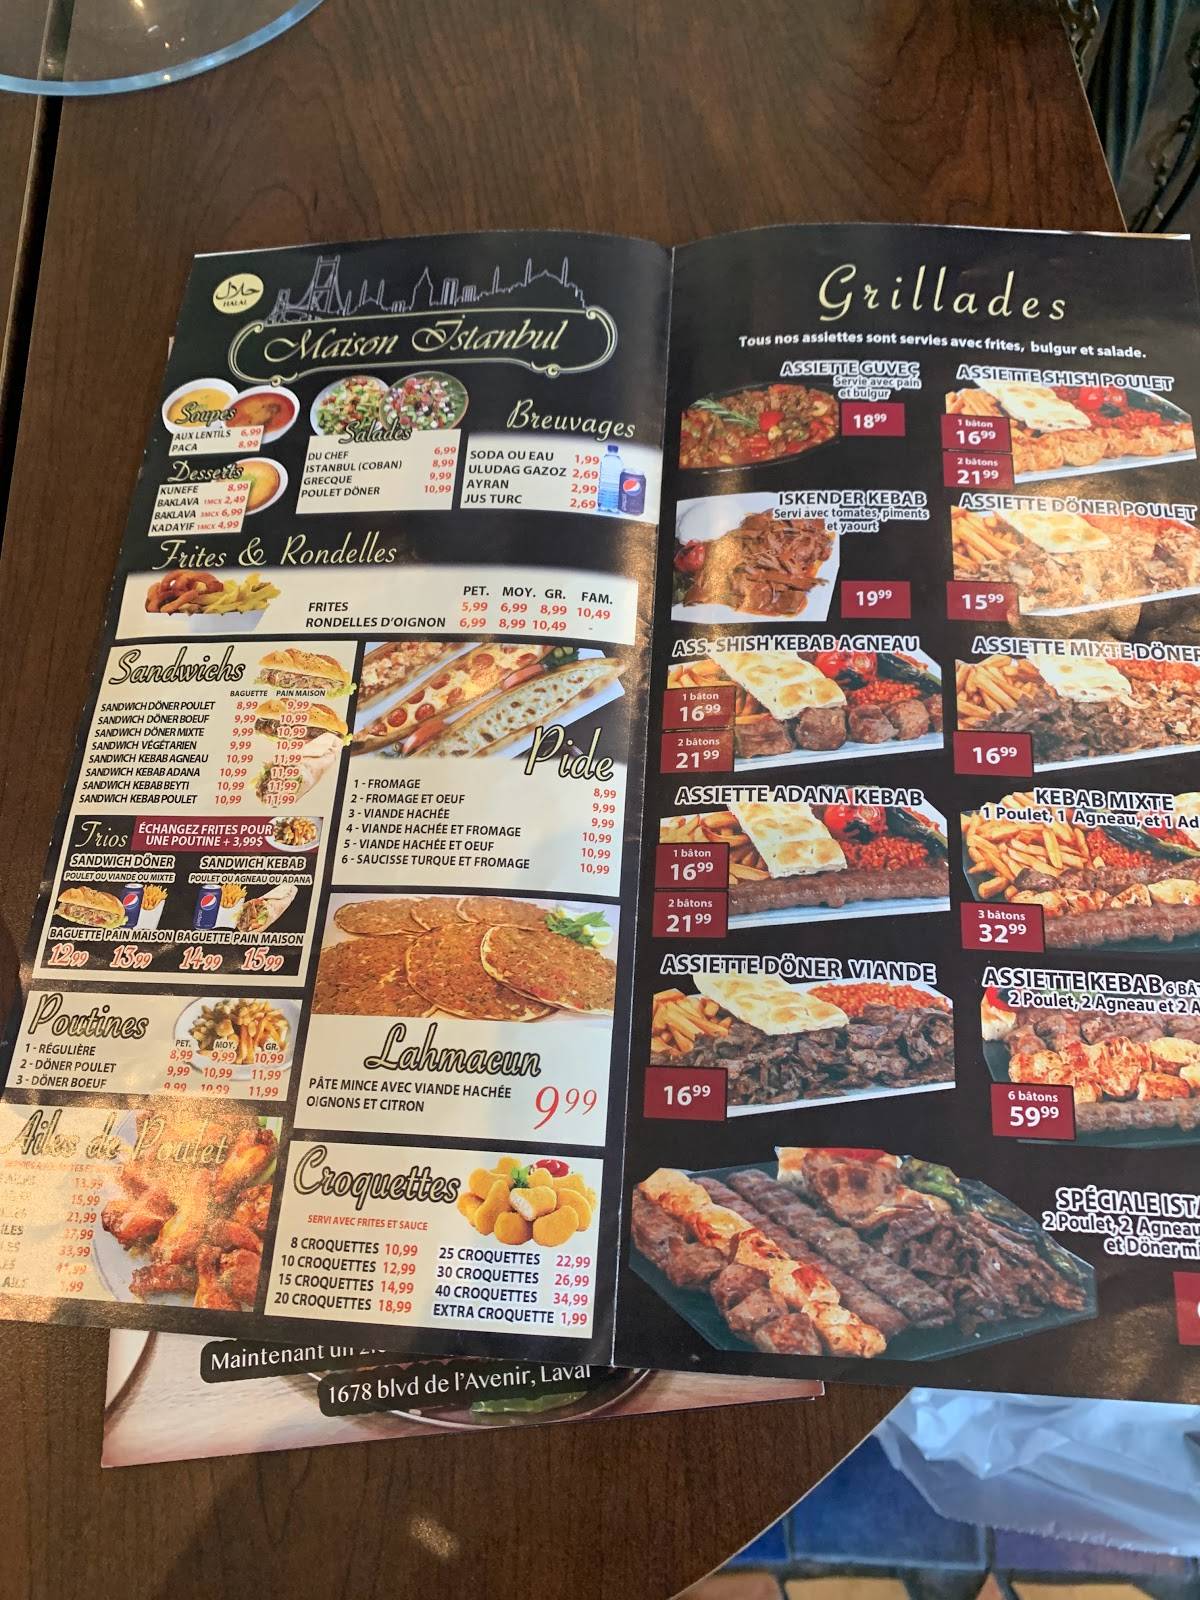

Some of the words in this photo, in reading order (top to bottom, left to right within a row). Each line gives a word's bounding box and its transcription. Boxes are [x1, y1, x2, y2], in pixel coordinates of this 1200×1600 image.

[818, 263, 1066, 322] Grillades
[264, 327, 399, 363] Maison
[738, 334, 772, 348] Tous
[774, 333, 799, 345] nos
[802, 330, 863, 343] assiettes
[866, 333, 897, 344] sont
[900, 334, 948, 346] servies
[950, 338, 982, 349] avec
[985, 338, 1024, 353] frites,
[1030, 341, 1076, 357] bulgur
[1080, 344, 1094, 356] et
[1097, 345, 1146, 358] salade.
[780, 360, 858, 376] ASSIETTE
[956, 364, 1043, 380] ASSIETTE
[1043, 371, 1099, 386] SHISH
[1100, 374, 1175, 391] POULET
[833, 375, 869, 388] Servie
[870, 378, 895, 387] avec
[895, 376, 921, 389] pain
[838, 389, 853, 398] et
[852, 388, 890, 401] bulgur
[174, 401, 237, 427] Soupes
[506, 399, 635, 441] Breuvages
[338, 418, 412, 444] Salades
[965, 420, 993, 428] bâton
[174, 431, 193, 440] AUX
[195, 429, 231, 439] LENTILS
[171, 444, 197, 452] PACA
[308, 452, 322, 461] DU
[324, 451, 349, 460] CHEF
[434, 446, 456, 455] 6,99
[470, 450, 504, 460] SODA
[507, 451, 526, 460] OU
[529, 452, 554, 461] EAU
[575, 454, 600, 465] 1,99
[167, 460, 244, 482] Desserts
[305, 464, 356, 473] ISTANBUL
[358, 460, 402, 471] (COBAN)
[468, 465, 520, 474] ULUDAG
[523, 466, 567, 477] GAZOZ
[965, 458, 998, 467] bâtons
[303, 475, 352, 485] GRECQUE
[466, 479, 509, 489] AYRAN
[160, 485, 199, 495] KUNEFE
[301, 488, 341, 497] POULET
[344, 485, 380, 496] DÖNER
[424, 485, 451, 494] 10,99
[464, 494, 486, 504] JUS
[489, 495, 522, 504] TURC
[777, 491, 865, 507] ISKENDER
[866, 490, 927, 507] KEBAB
[157, 497, 199, 507] BAKLAVA
[773, 508, 801, 520] Servi
[803, 508, 830, 519] avec
[831, 508, 880, 520] tomates,
[881, 508, 930, 521] piments
[151, 522, 195, 532] KADAYIF
[825, 522, 839, 532] et
[840, 521, 879, 534] yaourt
[152, 539, 227, 570] Frites
[238, 537, 266, 567] &
[280, 531, 397, 565] Rondelles
[463, 585, 489, 597] PET.
[502, 586, 536, 598] MOY.
[545, 588, 566, 600] GR.
[581, 591, 613, 605] FAM.
[308, 601, 348, 612] FRITES
[461, 601, 488, 613] 5,99
[306, 617, 378, 628] RONDELLES
[672, 639, 714, 657] ASS.
[715, 635, 770, 653] SHISH
[774, 635, 835, 652] KEBAB
[837, 635, 920, 653] AGNEAU
[971, 636, 1066, 656] ASSIETTE
[1069, 641, 1132, 660] MIXTE
[108, 645, 246, 685] Sandwichs
[100, 701, 147, 712] SANDWICH
[148, 700, 179, 711] DÖNER
[180, 701, 215, 710] POULET
[92, 741, 139, 750] SANDWICH
[141, 739, 197, 750] VÉGÉTARIEN
[524, 724, 614, 782] Pide
[367, 779, 421, 789] FROMAGE
[593, 788, 617, 799] 8,99
[674, 785, 770, 806] ASSIETTE
[771, 785, 847, 805] ADANA
[853, 788, 925, 807] KEBAB
[1033, 788, 1109, 809] KEBAB
[1109, 791, 1175, 812] MIXTE
[995, 806, 1053, 822] Poulet,
[1073, 809, 1141, 828] Agneau,
[74, 820, 128, 848] Trios
[138, 823, 200, 835] ÉCHANGEZ
[201, 824, 237, 835] FRITES
[239, 824, 273, 835] POUR
[146, 836, 169, 846] UNE
[171, 836, 221, 846] POUTINE
[233, 835, 263, 848] 3,99$
[356, 854, 409, 865] SAUCISSE
[411, 855, 456, 867] TURQUE
[458, 856, 472, 867] ET
[474, 857, 530, 869] FROMAGE
[580, 863, 609, 875] 10,99
[660, 953, 762, 975] ASSIETTE
[764, 952, 842, 980] DÖNER
[849, 960, 938, 984] VIANDE
[982, 966, 1085, 989] ASSIETTE
[1088, 973, 1165, 995] KEBAB
[27, 992, 149, 1040] Poutines
[38, 1042, 96, 1056] RÉGULIÈRE
[363, 1022, 542, 1078] Lahmacun
[35, 1058, 72, 1071] DÖNER
[74, 1061, 116, 1073] POULET
[309, 1076, 338, 1090] PÂTE
[340, 1079, 378, 1092] MINCE
[380, 1081, 412, 1094] AVEC
[415, 1082, 459, 1096] VIANDE
[462, 1084, 512, 1099] HACHÉE
[306, 1096, 361, 1110] OIGNONS
[363, 1099, 377, 1110] ET
[380, 1099, 425, 1112] CITRON
[293, 1145, 461, 1211] Croquettes
[1055, 1184, 1160, 1216] SPÉCIALE
[308, 1214, 331, 1225] SERVI
[332, 1216, 356, 1226] AVEC
[357, 1217, 384, 1228] FRITES
[386, 1219, 398, 1229] ET
[399, 1219, 428, 1231] SAUCE
[1057, 1212, 1119, 1235] Poulet,
[1104, 1239, 1125, 1254] et
[1126, 1237, 1179, 1256] Döner
[438, 1247, 454, 1260] 25
[457, 1248, 541, 1265] CROQUETTES
[556, 1255, 591, 1269] 22,99
[433, 1303, 474, 1319] EXTRA
[477, 1306, 554, 1324] CROQUETTE
[560, 1311, 588, 1326] 1,99
[211, 1342, 323, 1371] Maintenant
[328, 1383, 372, 1403] 1678
[377, 1375, 418, 1399] blvd
[424, 1376, 450, 1394] de
